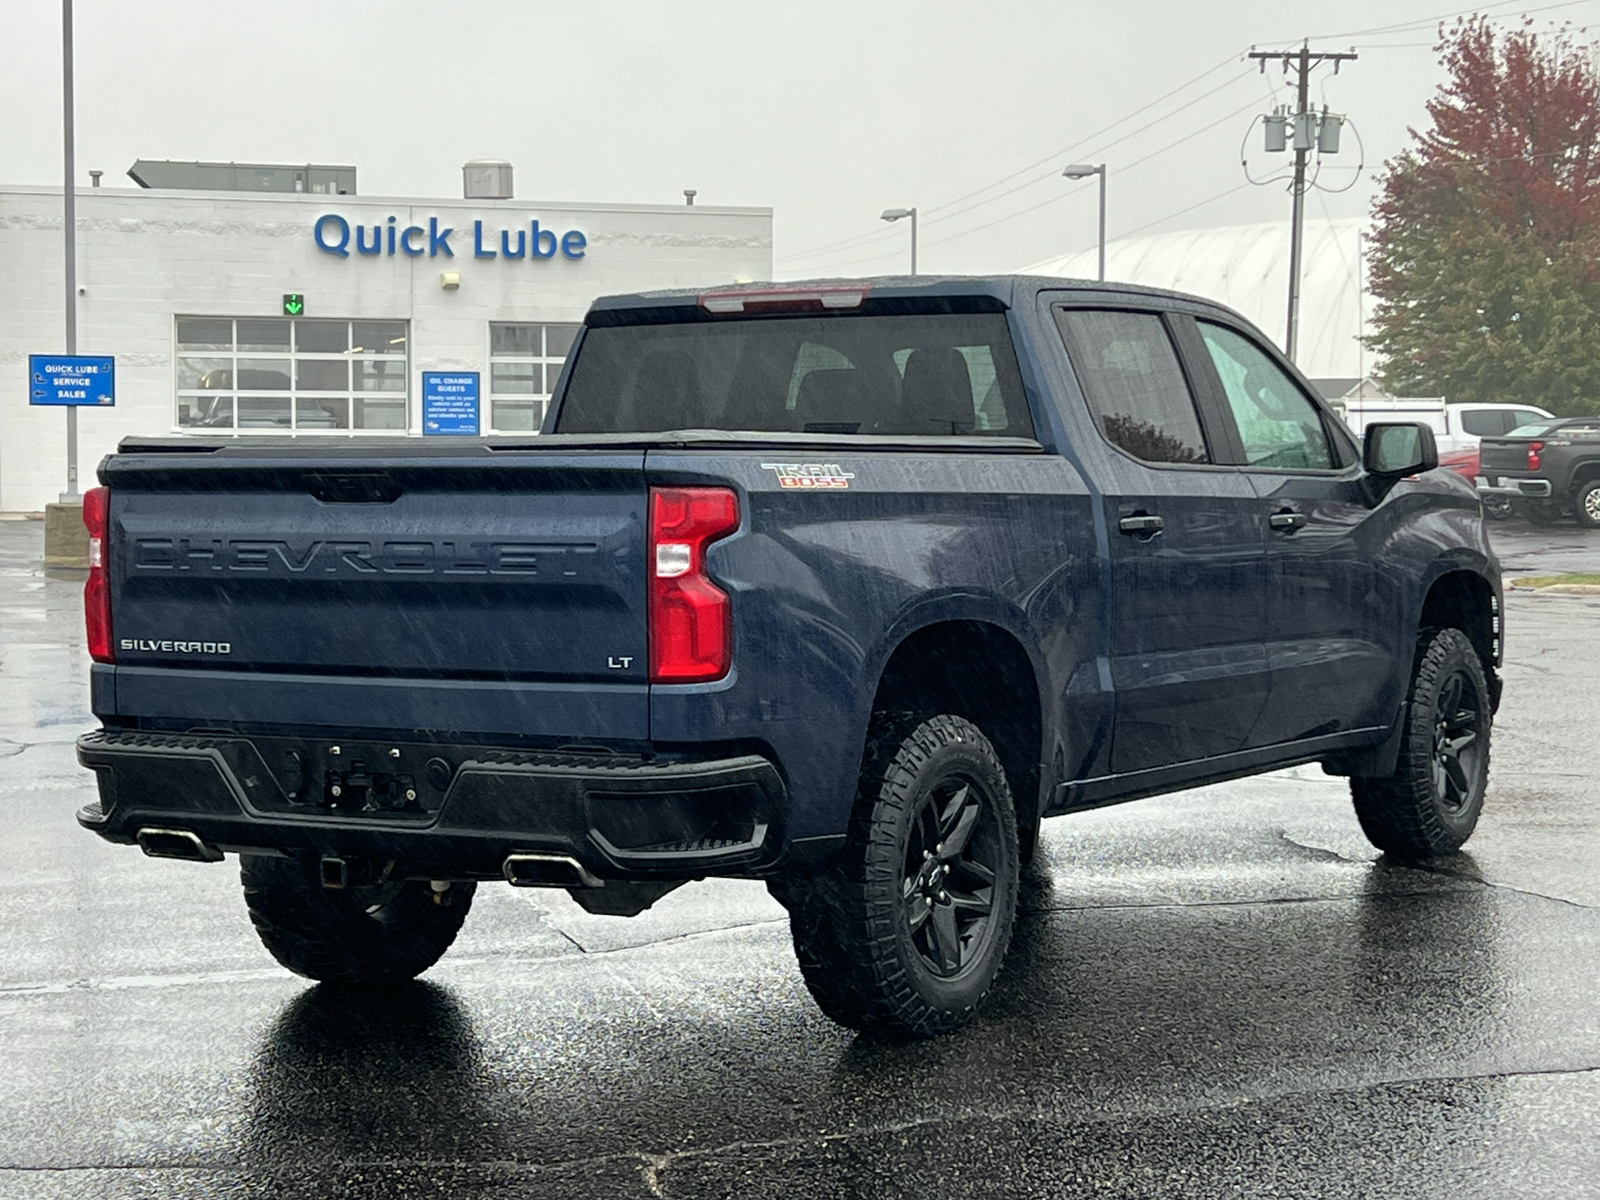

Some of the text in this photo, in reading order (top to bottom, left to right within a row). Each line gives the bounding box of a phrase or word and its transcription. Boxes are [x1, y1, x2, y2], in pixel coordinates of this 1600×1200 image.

[314, 214, 588, 260] Quick Lube
[45, 365, 98, 374] QUICK LUBE
[53, 378, 90, 386] SERVICE
[58, 390, 86, 398] SALES
[761, 463, 855, 479] TRAIL
[780, 477, 849, 488] BOSS
[135, 538, 597, 576] CHEVROLET
[121, 639, 231, 654] SILVERADO
[608, 656, 633, 668] LT
